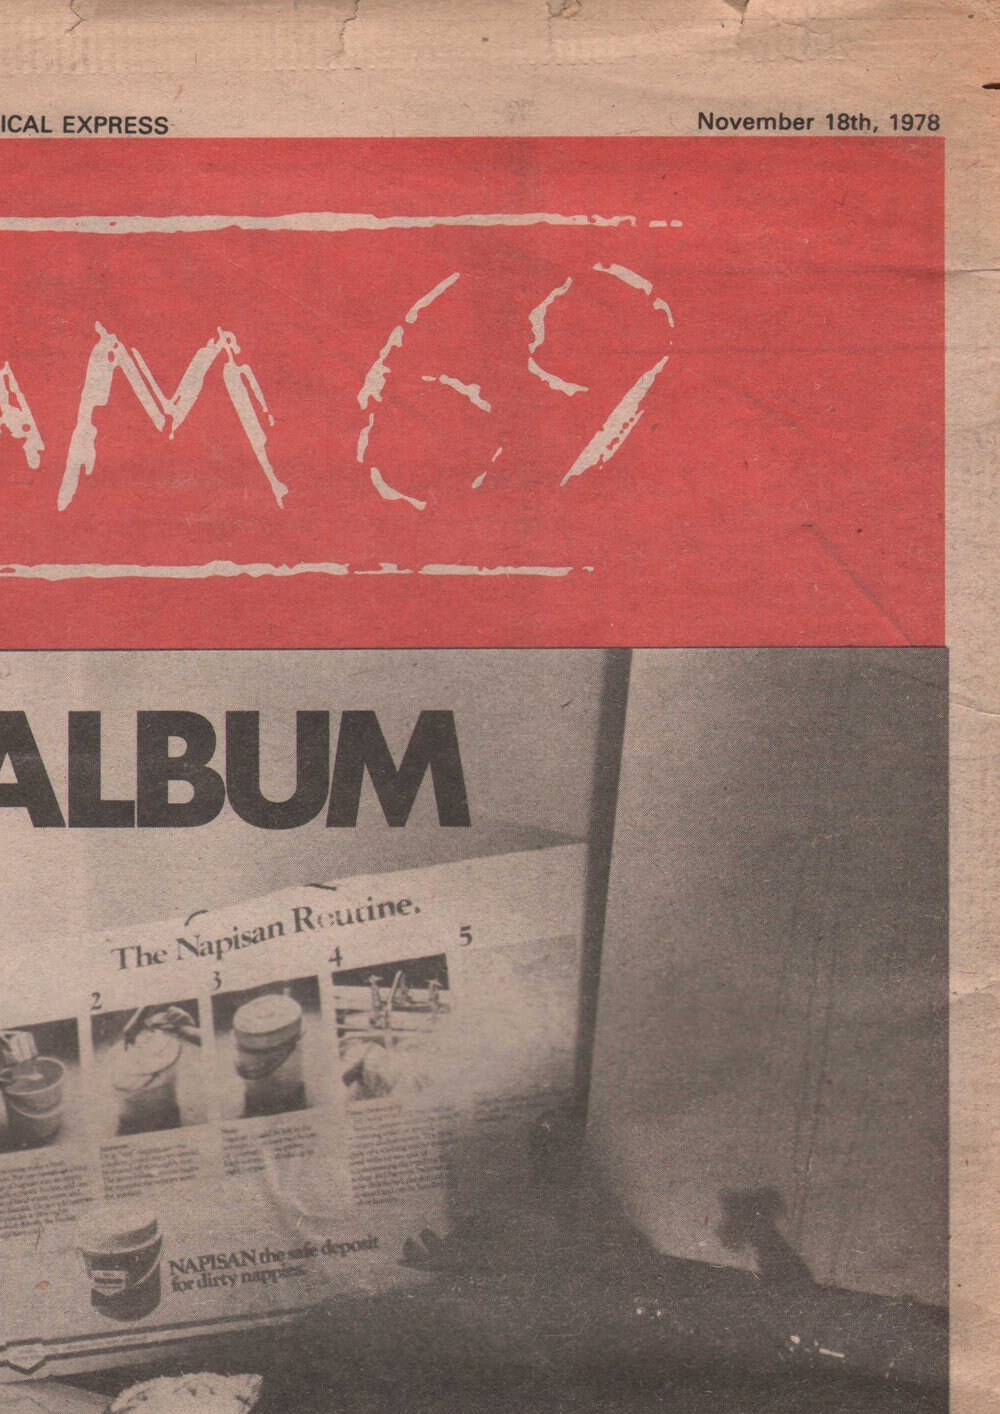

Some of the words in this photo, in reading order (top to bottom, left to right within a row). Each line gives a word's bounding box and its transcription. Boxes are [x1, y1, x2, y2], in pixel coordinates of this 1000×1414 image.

[62, 115, 169, 135] EXPRESS
[697, 112, 815, 131] November
[825, 112, 879, 133] 18th,
[889, 113, 941, 132] 1978
[356, 262, 677, 512] 69
[110, 945, 168, 971] The
[175, 920, 285, 961] Napisan
[291, 896, 422, 933] Routine.
[458, 924, 473, 947] 5
[327, 945, 344, 968] 4
[210, 970, 222, 990] 3
[90, 991, 103, 1010] 2
[168, 1248, 257, 1277] NAPISAN
[259, 1246, 286, 1265] the
[170, 1276, 194, 1293] for
[197, 1270, 237, 1288] dirty
